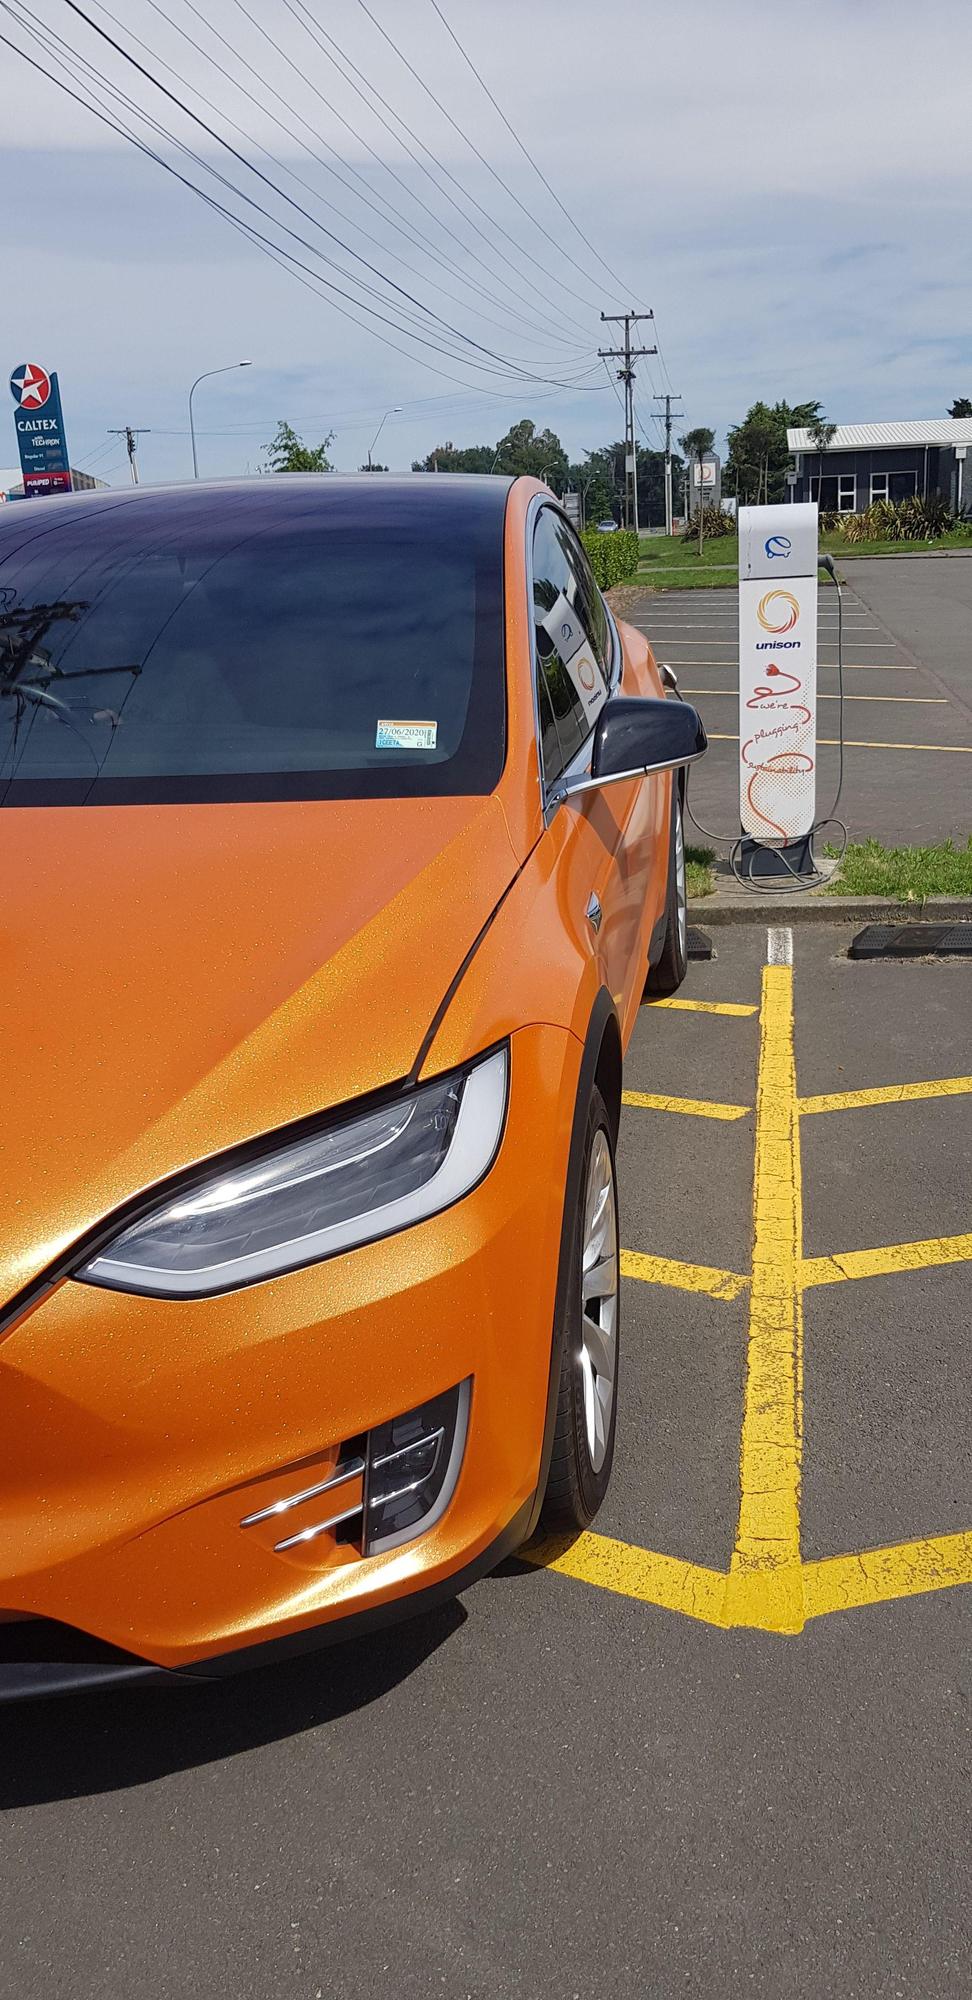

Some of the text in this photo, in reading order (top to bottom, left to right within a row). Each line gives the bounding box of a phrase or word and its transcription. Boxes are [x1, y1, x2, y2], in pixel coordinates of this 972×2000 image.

[18, 419, 58, 432] CALTEX
[32, 438, 60, 447] TECHRON
[27, 478, 50, 486] PUMPED
[756, 640, 801, 650] unison
[760, 701, 789, 709] we're
[379, 728, 424, 736] 27/06/2020
[754, 722, 799, 744] plugging
